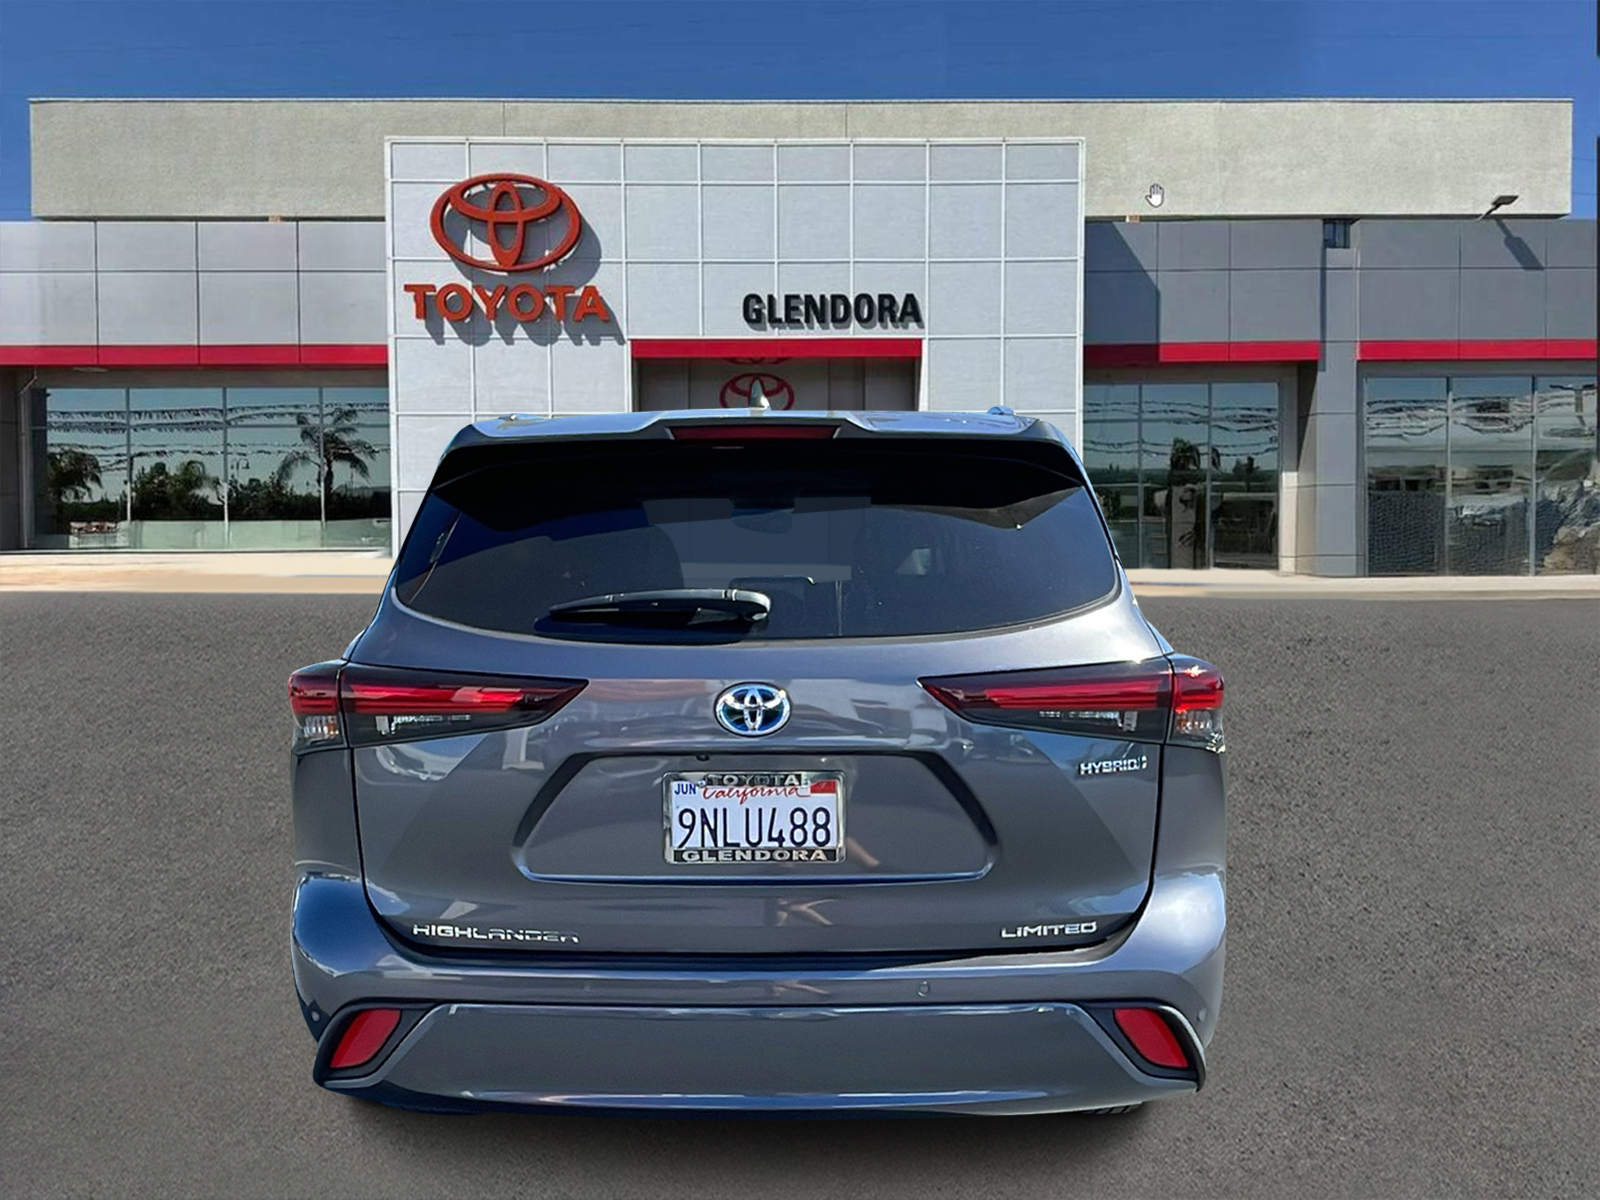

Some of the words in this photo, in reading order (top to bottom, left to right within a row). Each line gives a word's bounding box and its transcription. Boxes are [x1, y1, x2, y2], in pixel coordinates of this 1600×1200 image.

[403, 283, 611, 323] TOYOTA
[742, 293, 923, 326] GLENDORA
[1079, 757, 1141, 776] HYBRID
[674, 783, 697, 795] JUN
[710, 774, 800, 787] TOYOTA
[678, 807, 831, 849] 9NLU488
[682, 849, 828, 862] GLENDORA
[412, 924, 580, 943] HIGHLANDER
[1001, 921, 1098, 938] LIMITED
